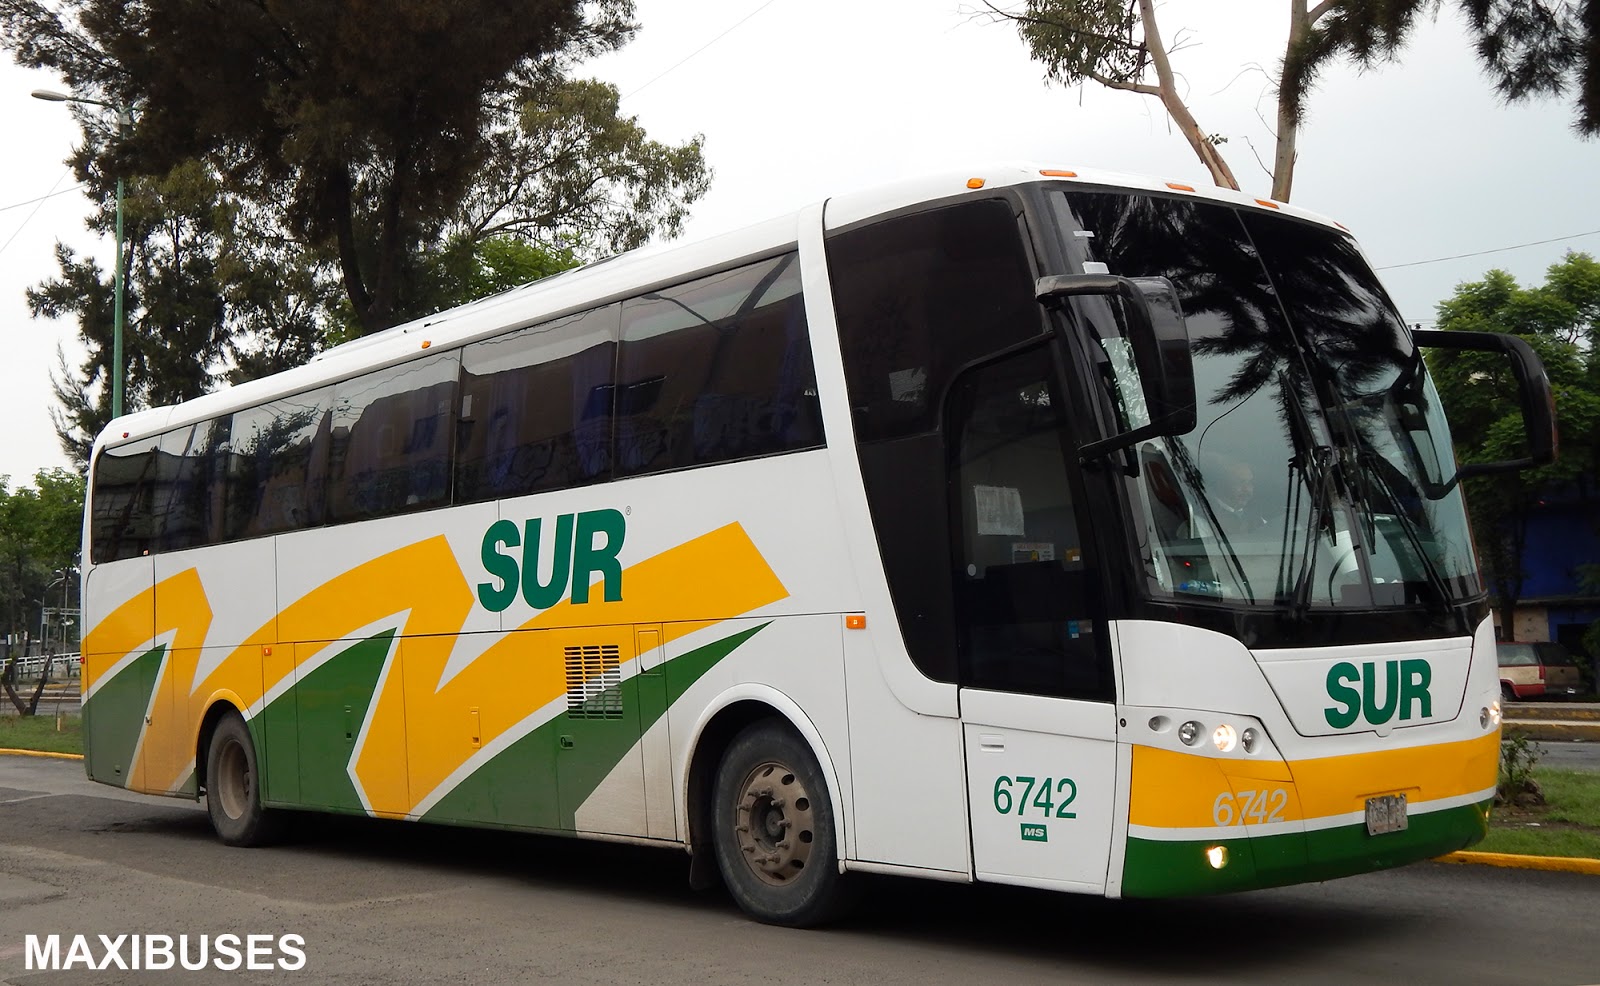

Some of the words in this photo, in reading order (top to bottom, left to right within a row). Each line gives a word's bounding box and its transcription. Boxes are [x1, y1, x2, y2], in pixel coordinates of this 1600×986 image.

[477, 508, 626, 613] SUR
[1324, 659, 1432, 729] SUR
[993, 775, 1077, 819] 6742
[1213, 788, 1288, 827] 6742
[1023, 827, 1045, 838] MS
